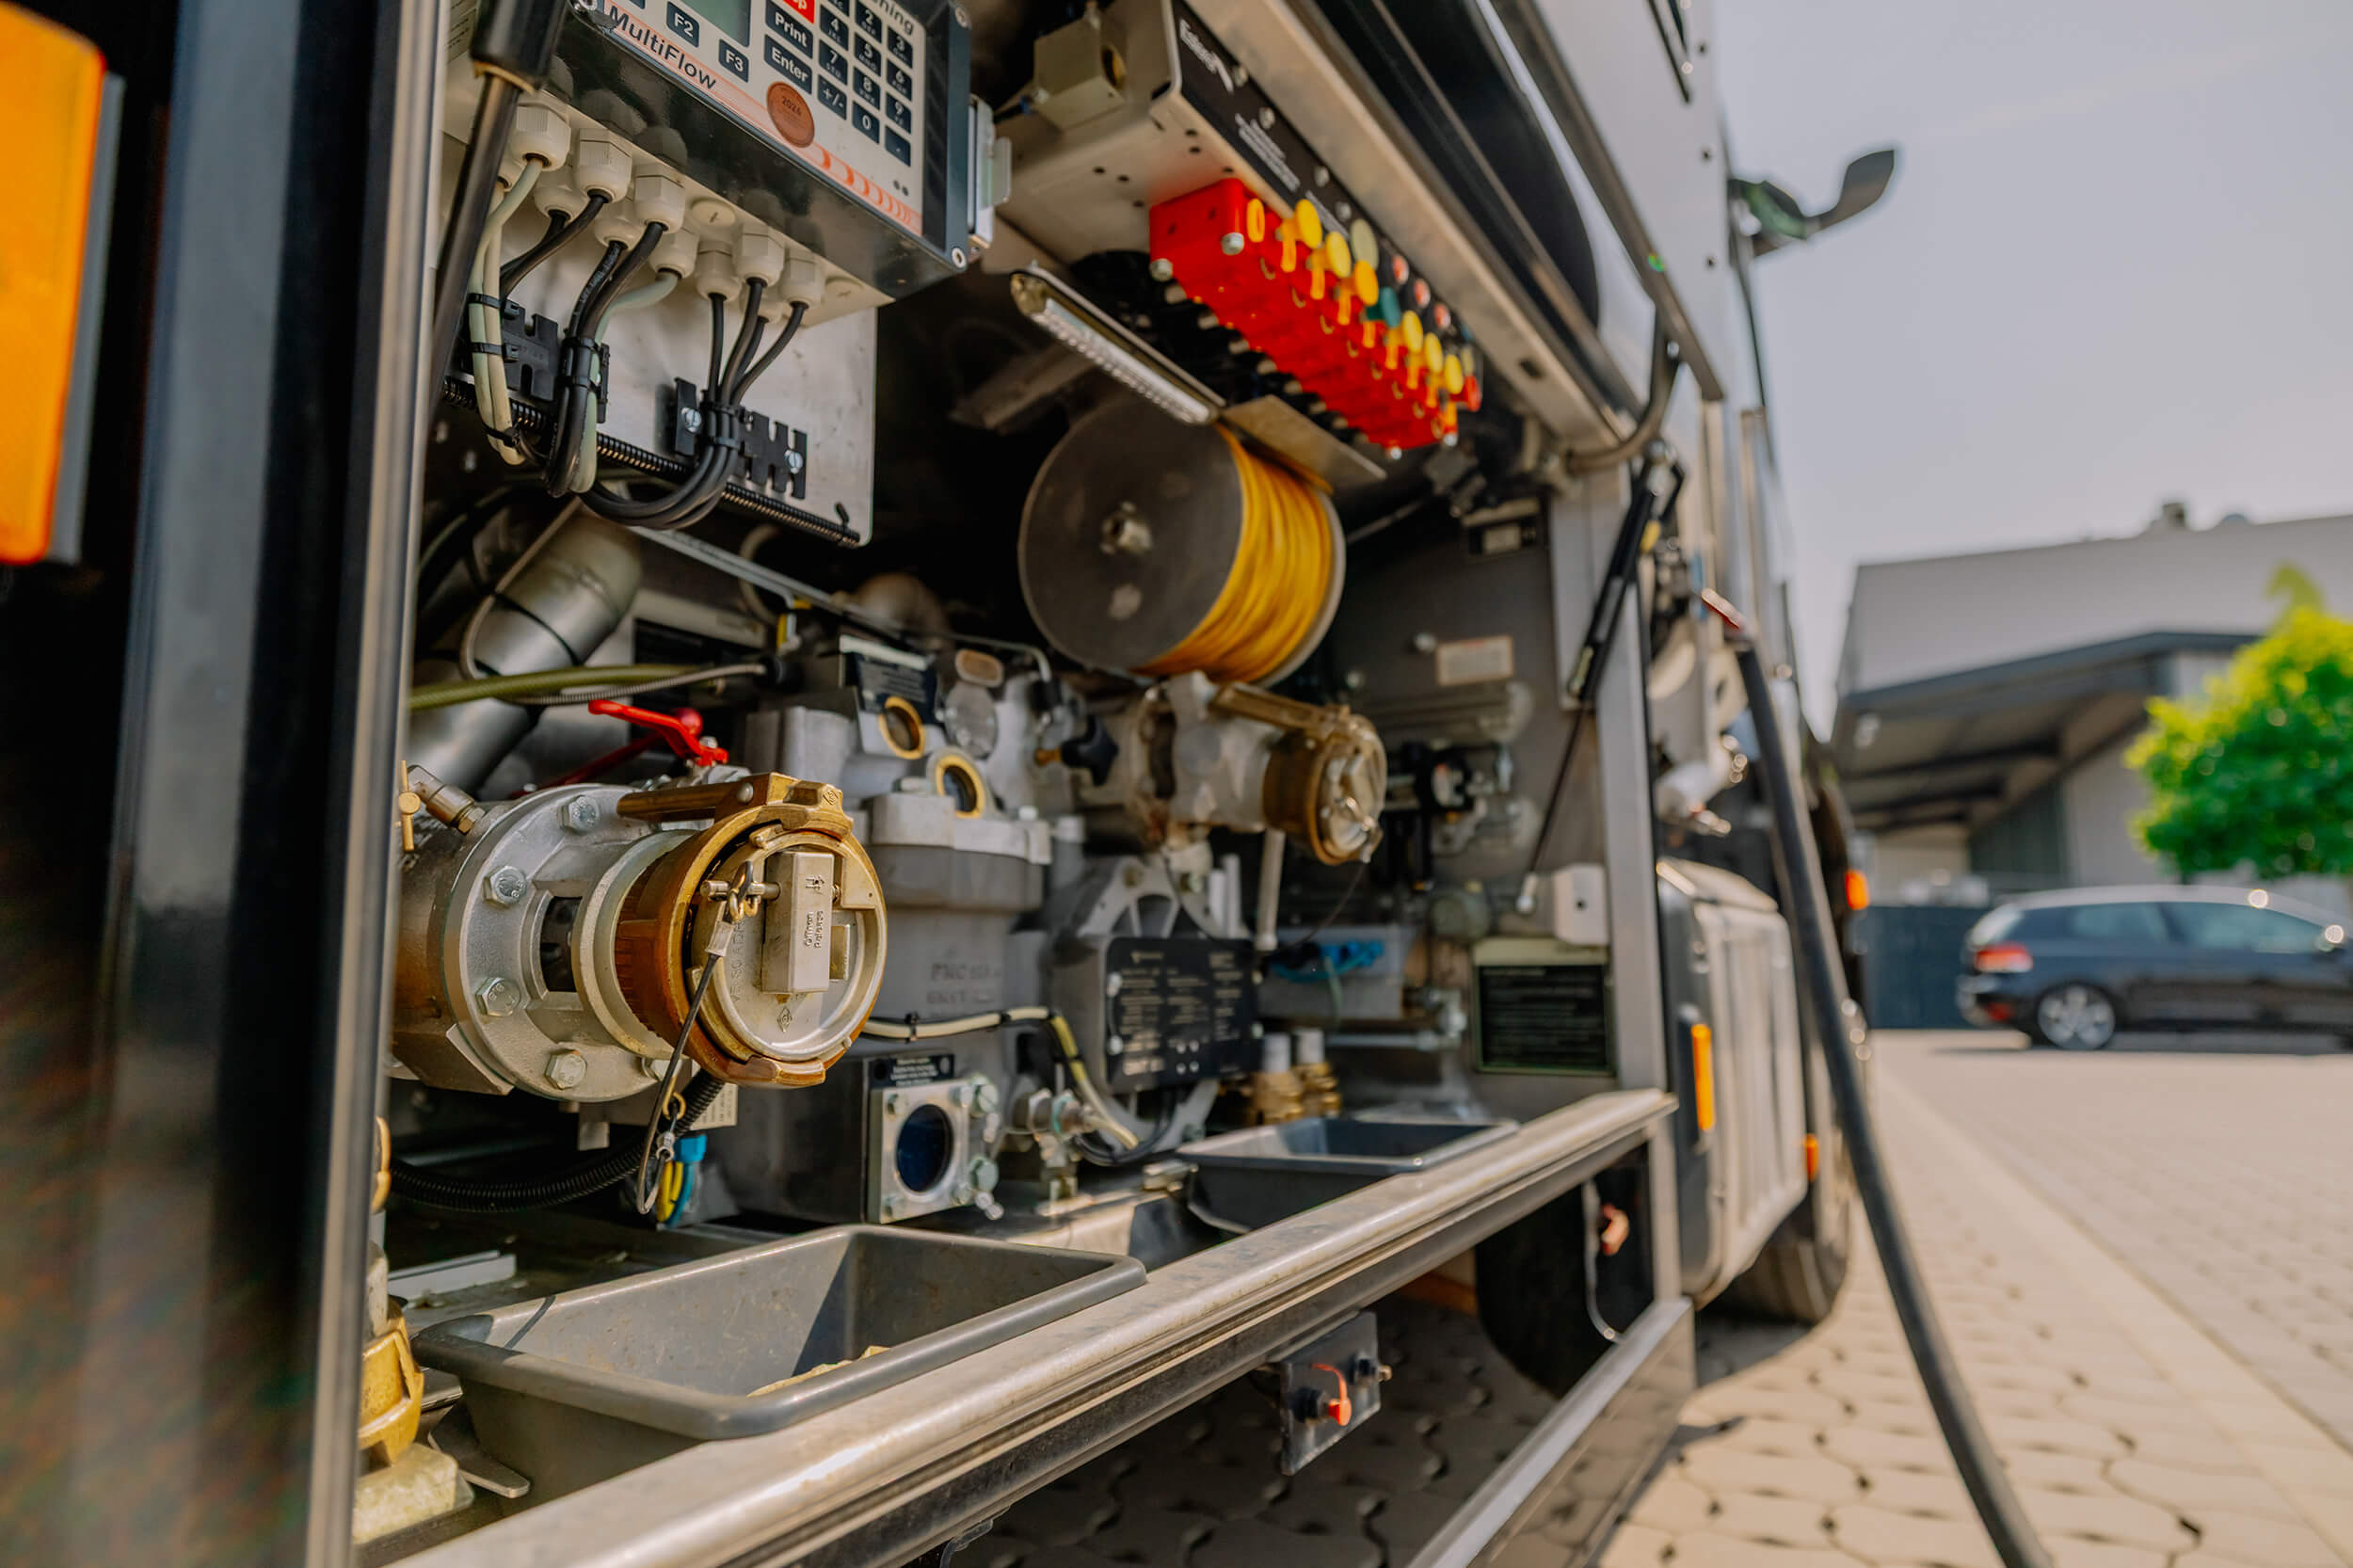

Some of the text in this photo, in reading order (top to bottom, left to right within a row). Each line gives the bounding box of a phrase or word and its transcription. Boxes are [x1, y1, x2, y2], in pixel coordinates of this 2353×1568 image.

[674, 12, 695, 38] F2
[830, 19, 840, 31] 4
[865, 9, 874, 26] 2
[873, 0, 914, 36] ning
[775, 11, 808, 47] Print
[610, 6, 716, 89] MultiFlow
[864, 43, 873, 59] 5
[896, 36, 905, 53] 3
[725, 49, 744, 72] F3
[829, 49, 839, 64] 7
[771, 47, 808, 84] Enter
[863, 76, 873, 93] 8
[895, 70, 905, 85] 6
[895, 101, 904, 116] 9
[861, 114, 872, 130] 0
